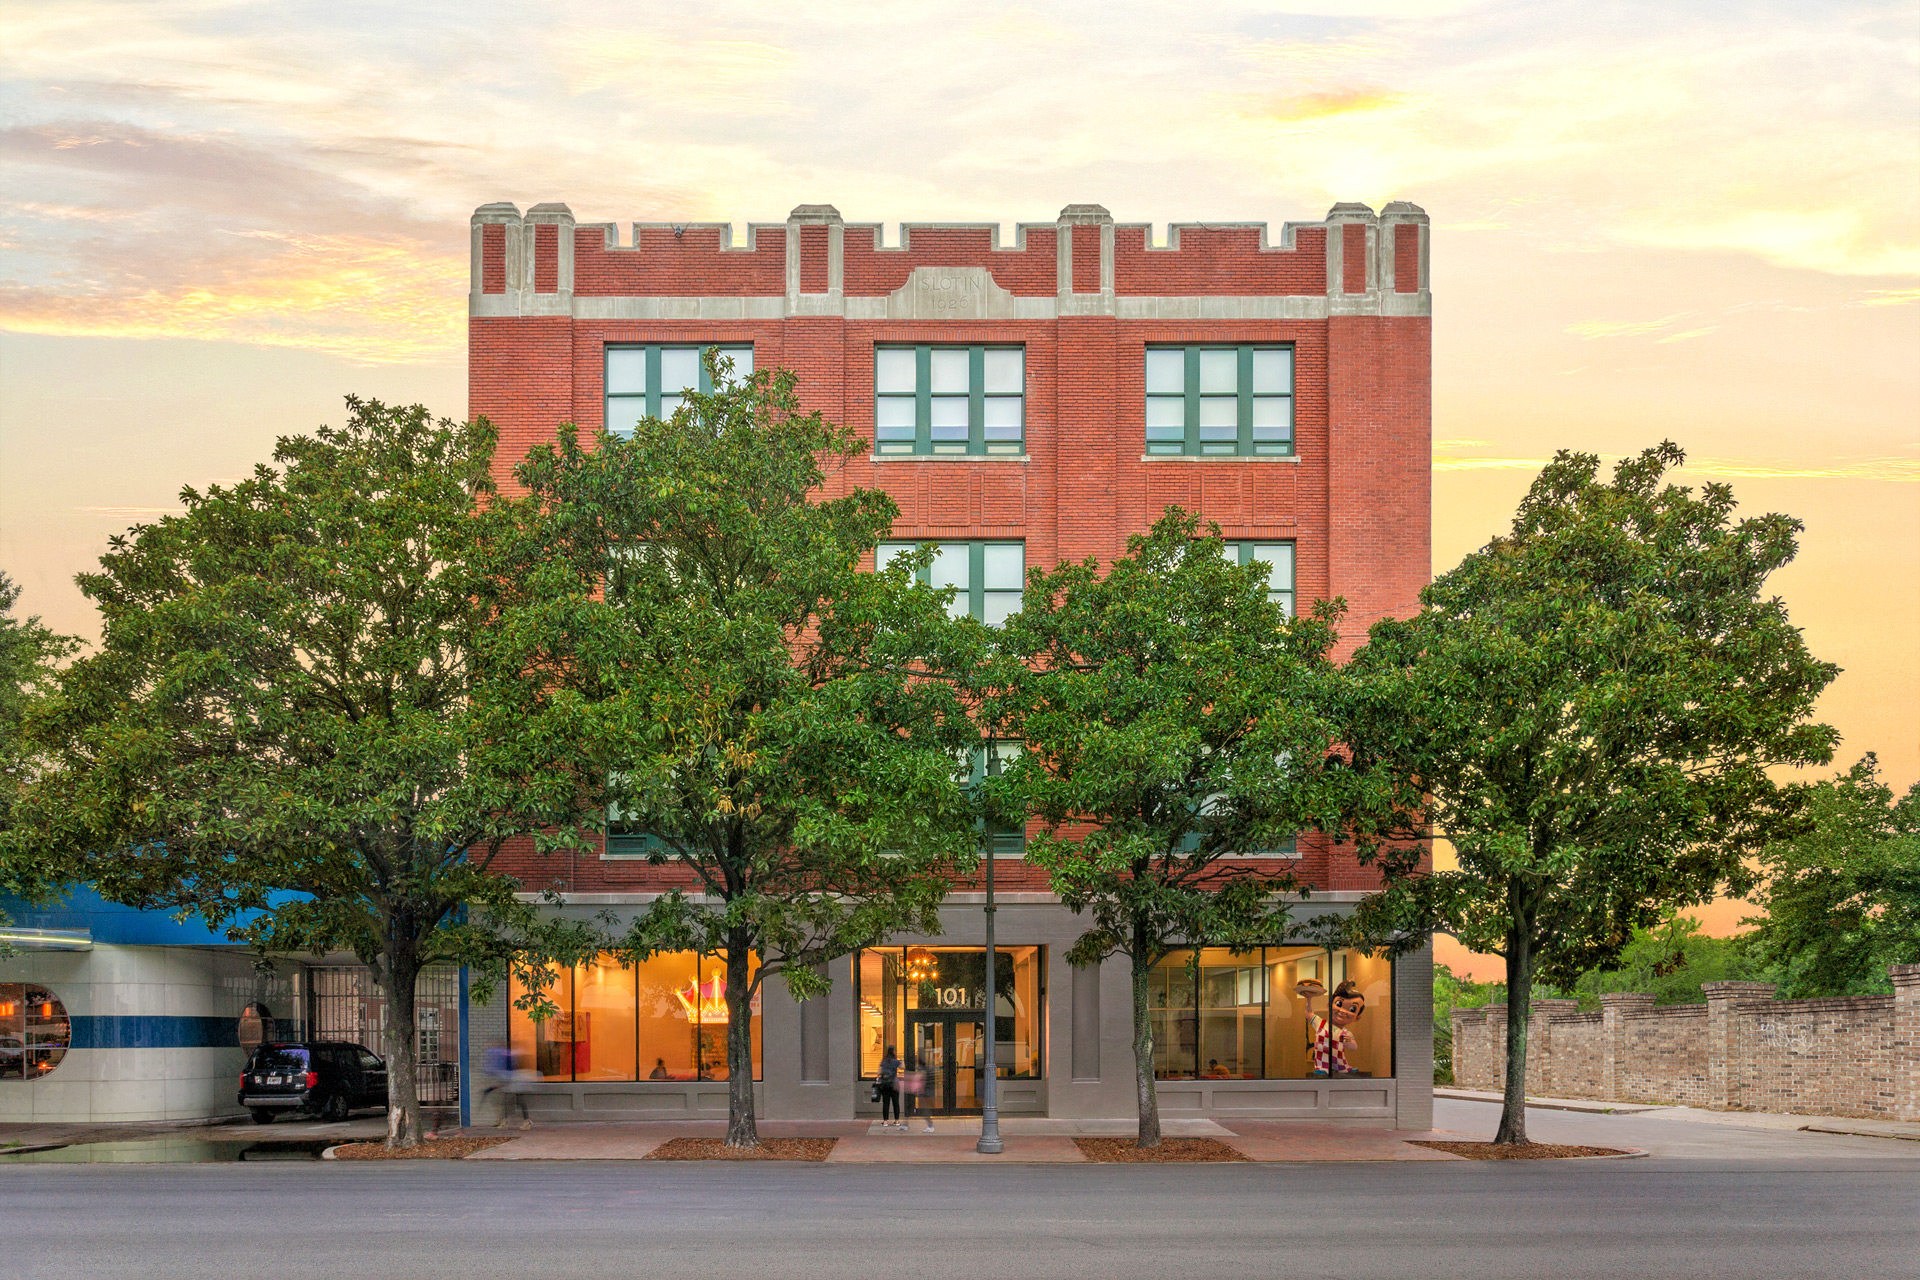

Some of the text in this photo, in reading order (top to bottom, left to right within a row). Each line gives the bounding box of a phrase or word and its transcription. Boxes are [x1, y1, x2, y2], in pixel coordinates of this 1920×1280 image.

[921, 277, 980, 291] SLOTIN
[931, 296, 968, 312] 1926
[935, 988, 966, 1005] 101
